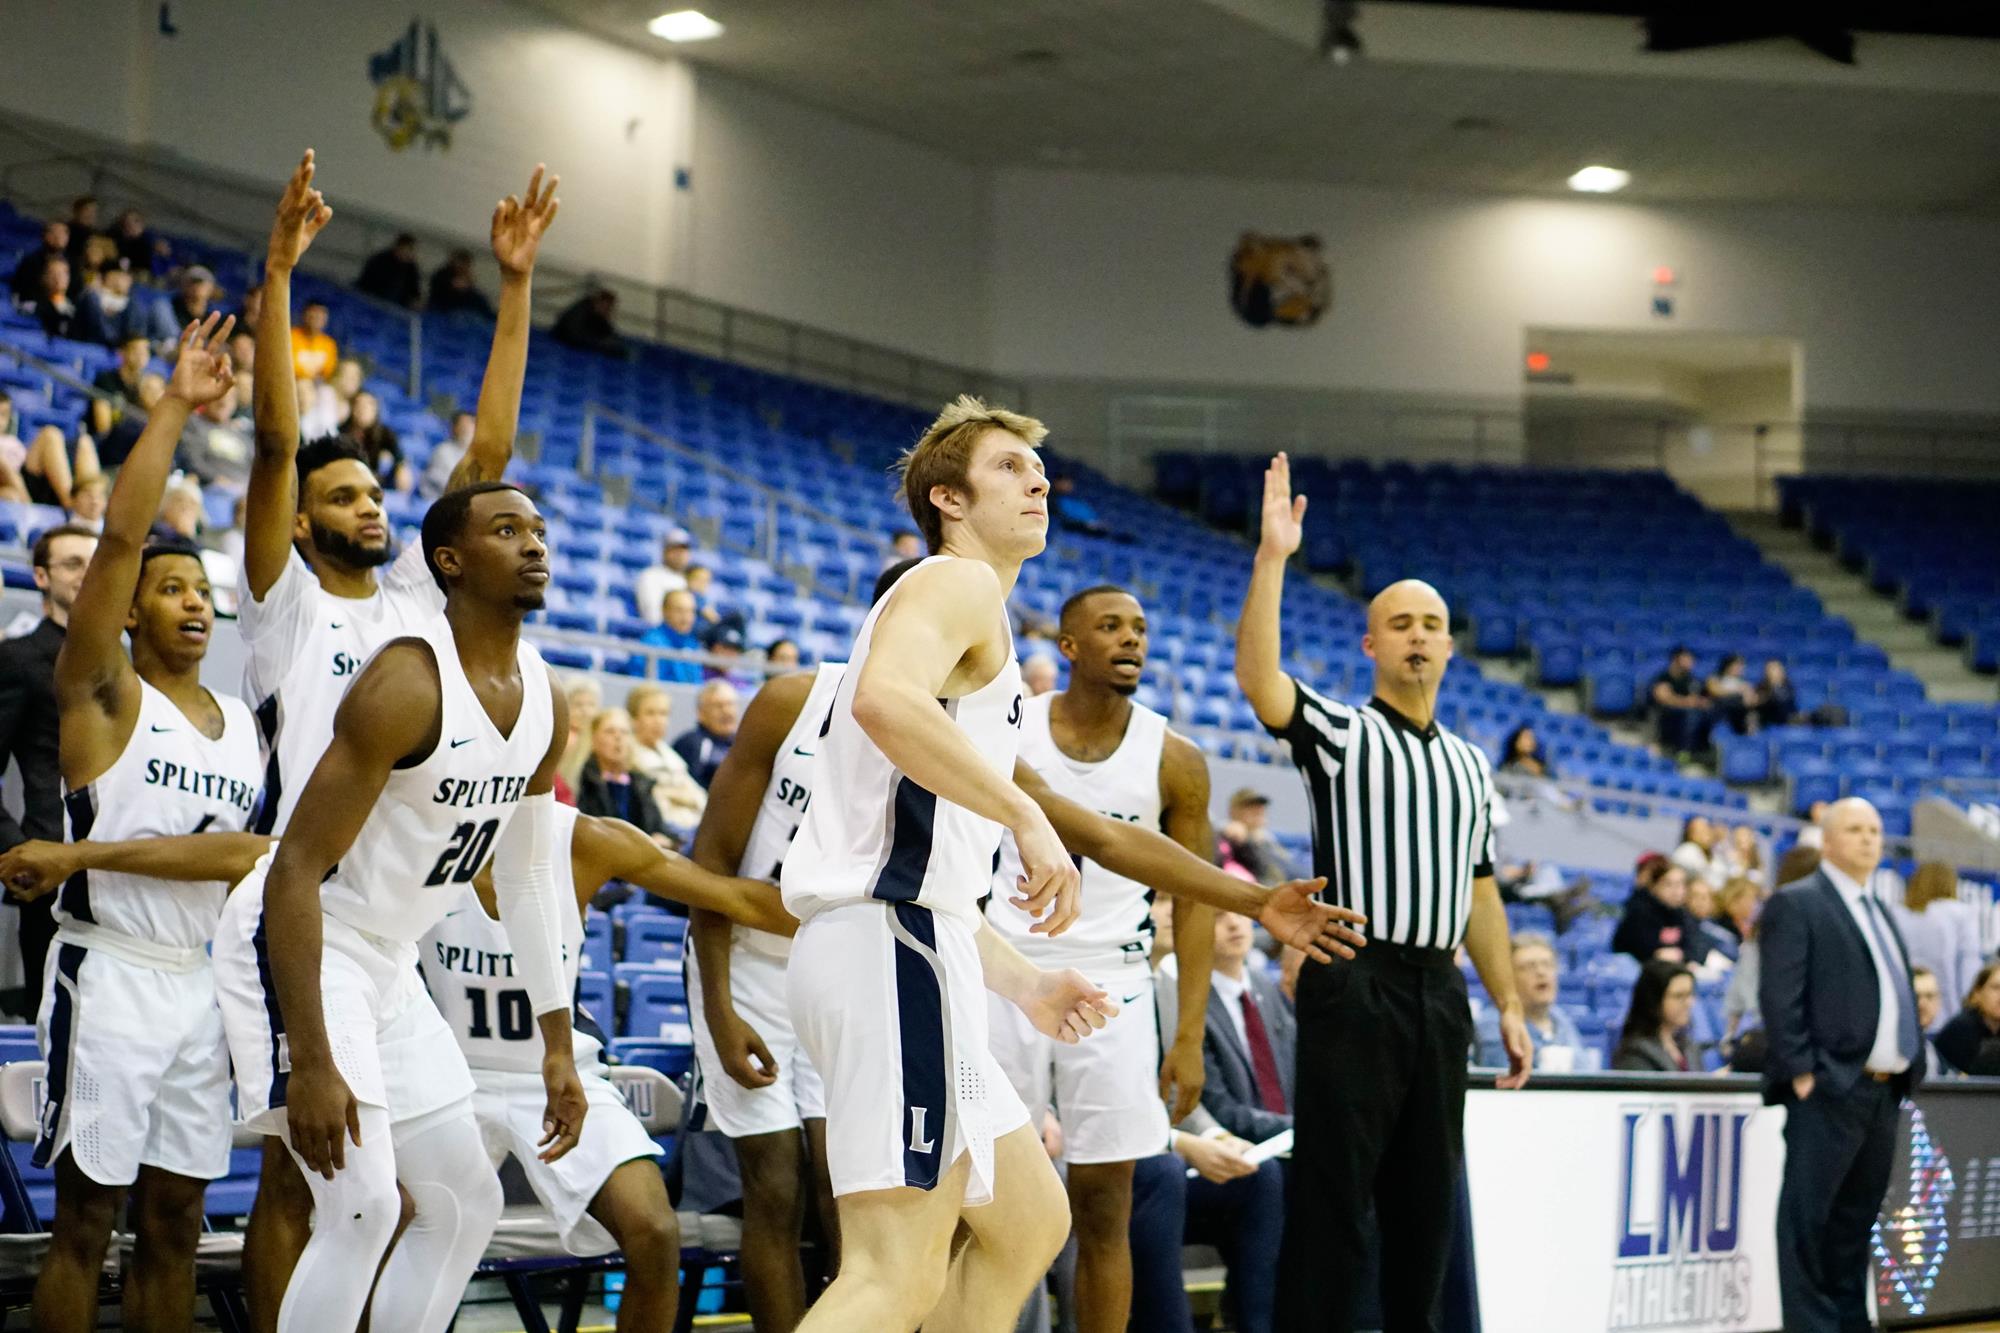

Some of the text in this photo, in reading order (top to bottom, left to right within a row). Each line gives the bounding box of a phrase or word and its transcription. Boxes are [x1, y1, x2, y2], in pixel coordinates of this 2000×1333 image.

[145, 758, 254, 811] SPLITTERS
[432, 776, 526, 808] SPLITER
[423, 818, 500, 887] 20
[436, 941, 567, 977] SPLITT
[465, 987, 533, 1041] 10
[909, 1106, 935, 1154] L
[1613, 1103, 1757, 1262] LMU
[1608, 1259, 1750, 1329] ATHLETICS
